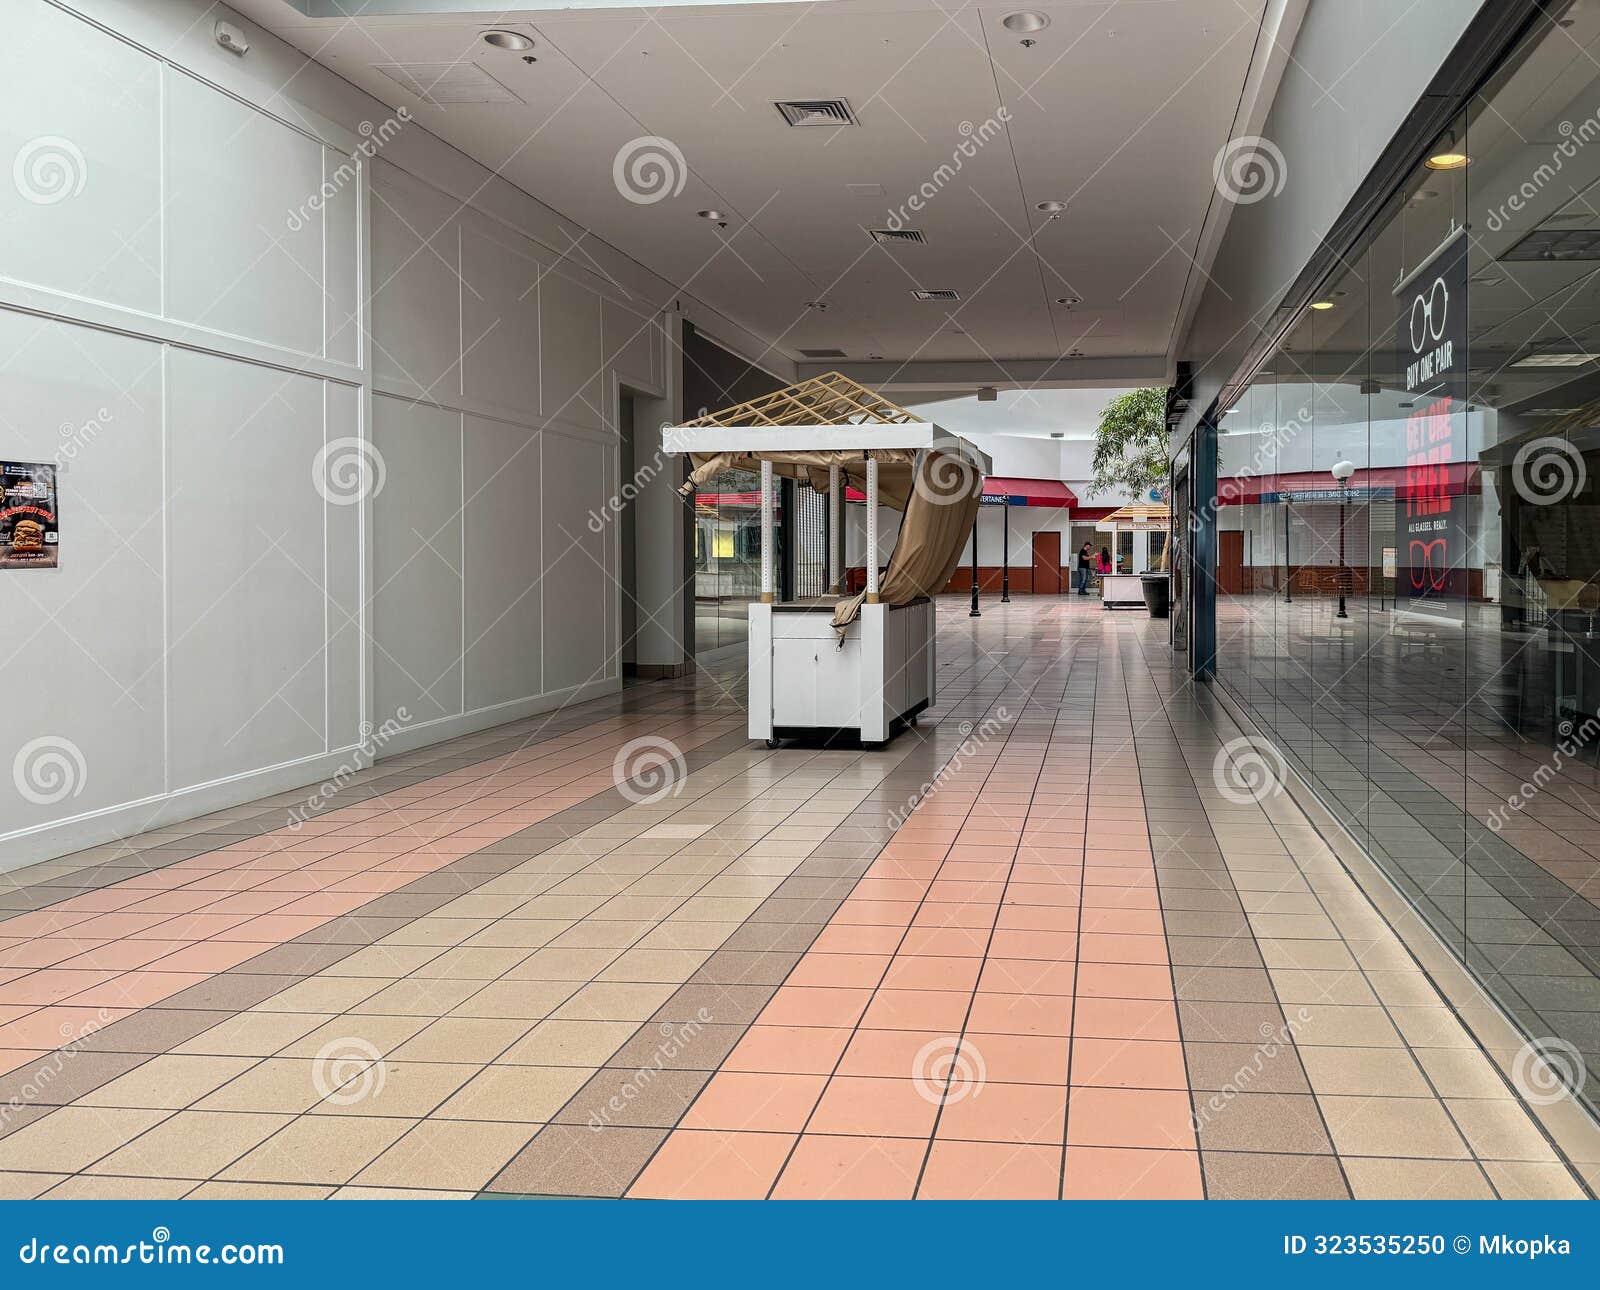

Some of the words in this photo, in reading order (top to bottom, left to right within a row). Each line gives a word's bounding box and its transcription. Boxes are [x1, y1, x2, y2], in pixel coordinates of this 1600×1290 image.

[1407, 366, 1419, 391] BUY
[1420, 351, 1434, 383] ONE
[1435, 340, 1453, 375] PAIR
[1407, 408, 1425, 451] GET
[1428, 396, 1453, 443] ONE
[1406, 443, 1452, 518] FREE
[1415, 521, 1433, 532] GLASSES.
[1433, 519, 1448, 531] REALLY.
